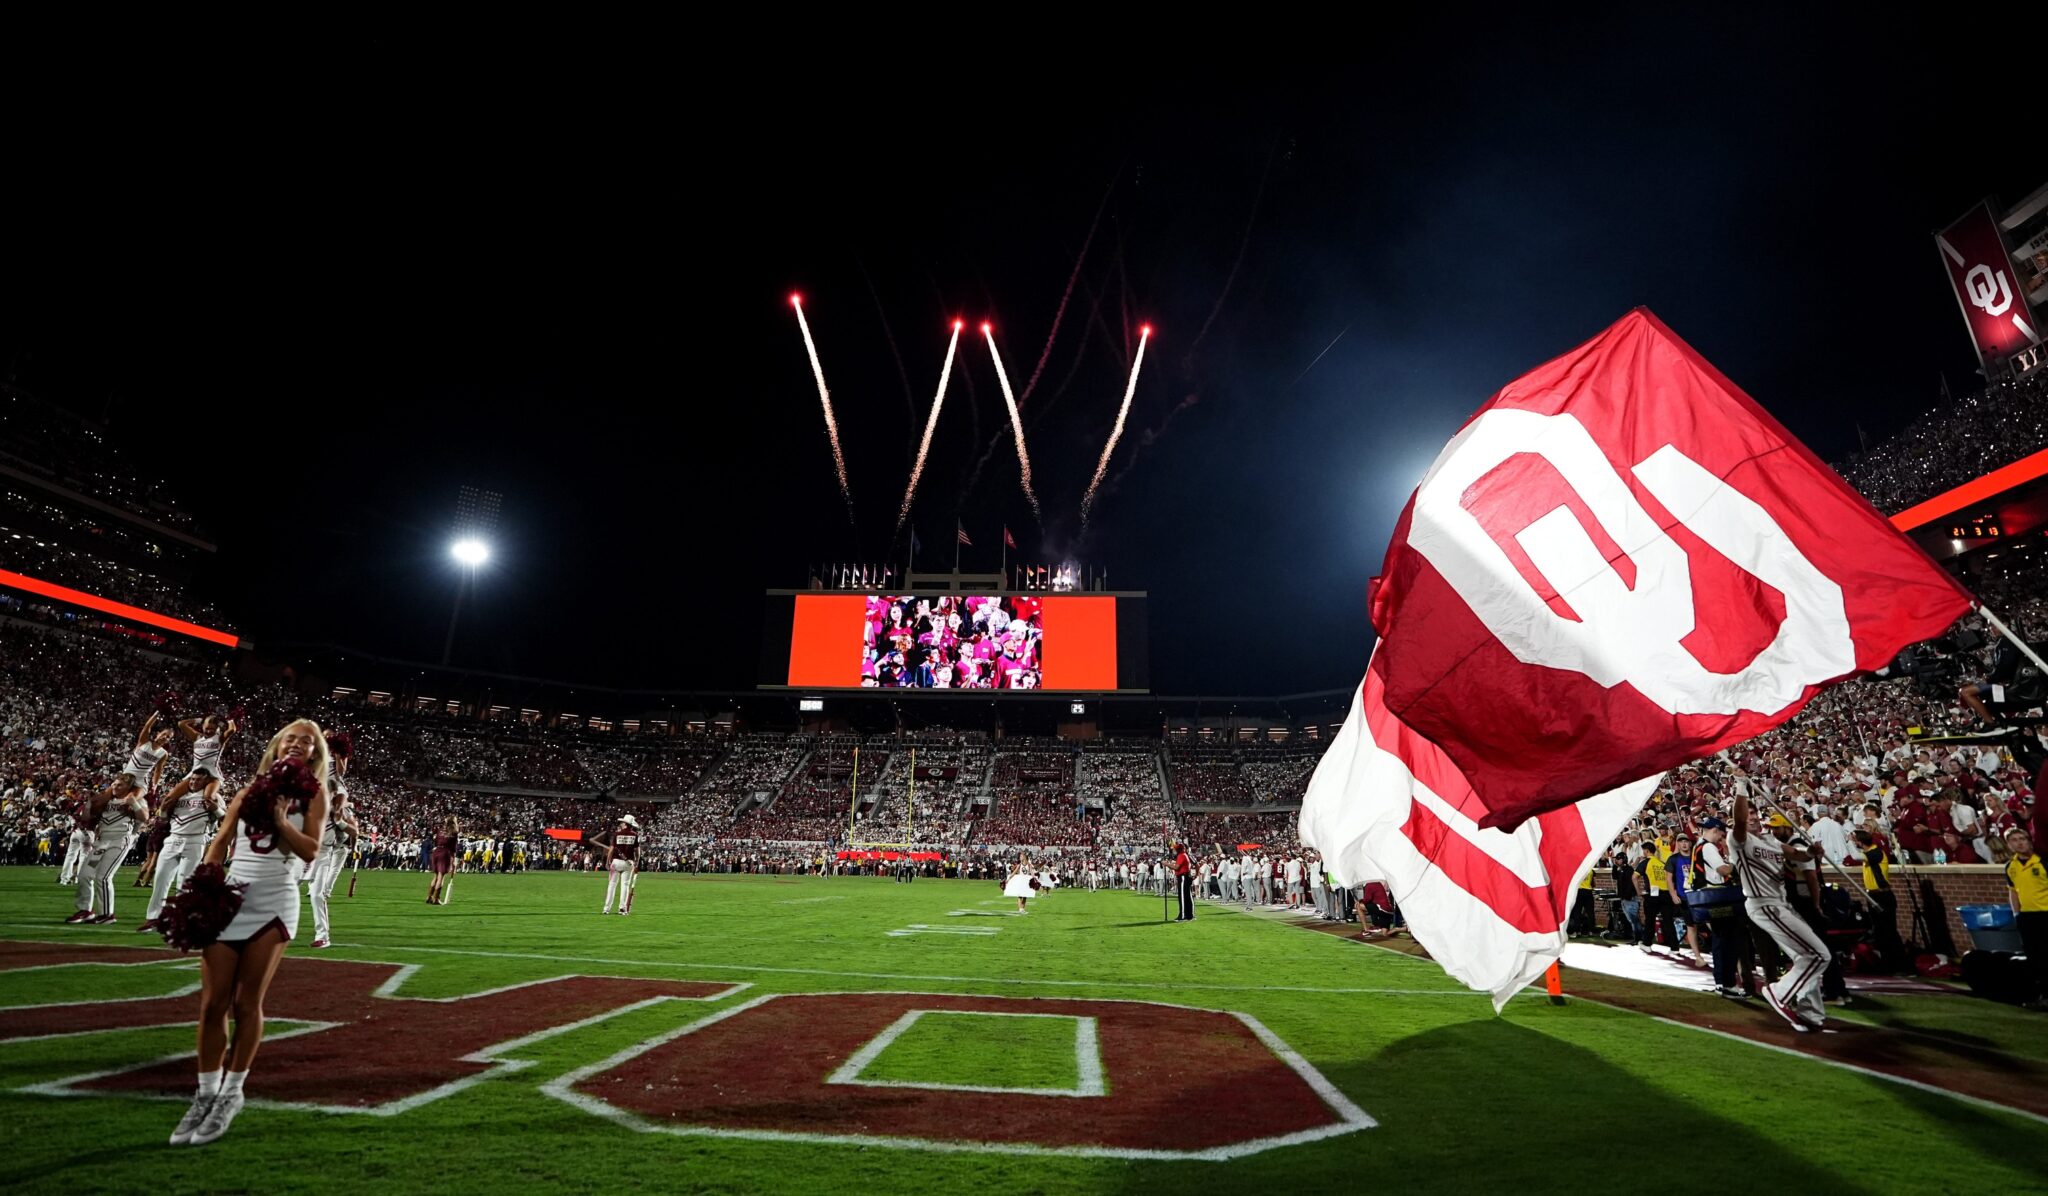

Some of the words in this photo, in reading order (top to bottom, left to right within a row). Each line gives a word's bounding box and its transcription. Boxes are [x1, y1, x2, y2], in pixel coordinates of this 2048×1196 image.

[1965, 263, 2013, 316] OU
[1408, 408, 1857, 717] OU
[1073, 704, 1083, 713] 25
[928, 767, 943, 777] OU
